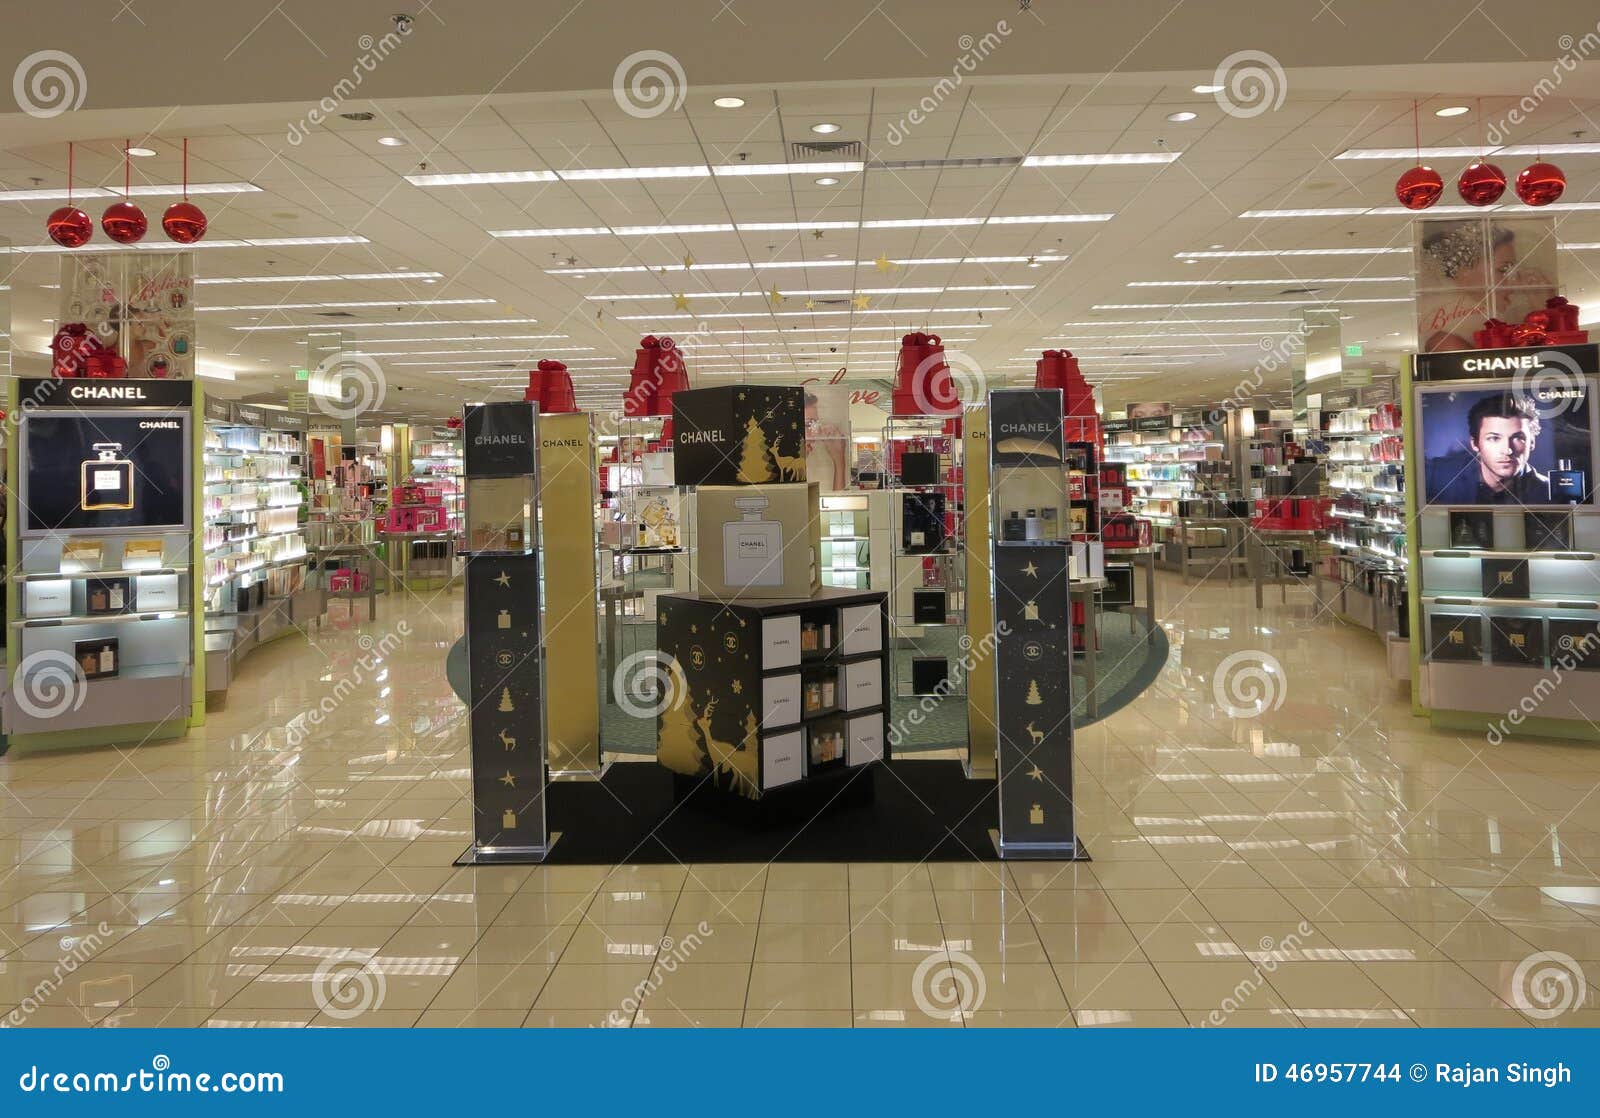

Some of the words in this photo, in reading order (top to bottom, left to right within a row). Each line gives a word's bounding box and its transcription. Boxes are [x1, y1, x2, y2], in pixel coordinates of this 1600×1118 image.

[1463, 355, 1544, 371] CHANEL
[70, 386, 146, 399] CHANEL
[1538, 390, 1584, 400] CHANEL
[139, 421, 180, 429] CHANEL
[1000, 423, 1052, 433] CHANEL
[474, 434, 525, 445] CHANEL
[680, 430, 725, 443] CHANEL
[542, 439, 583, 448] CHANEL
